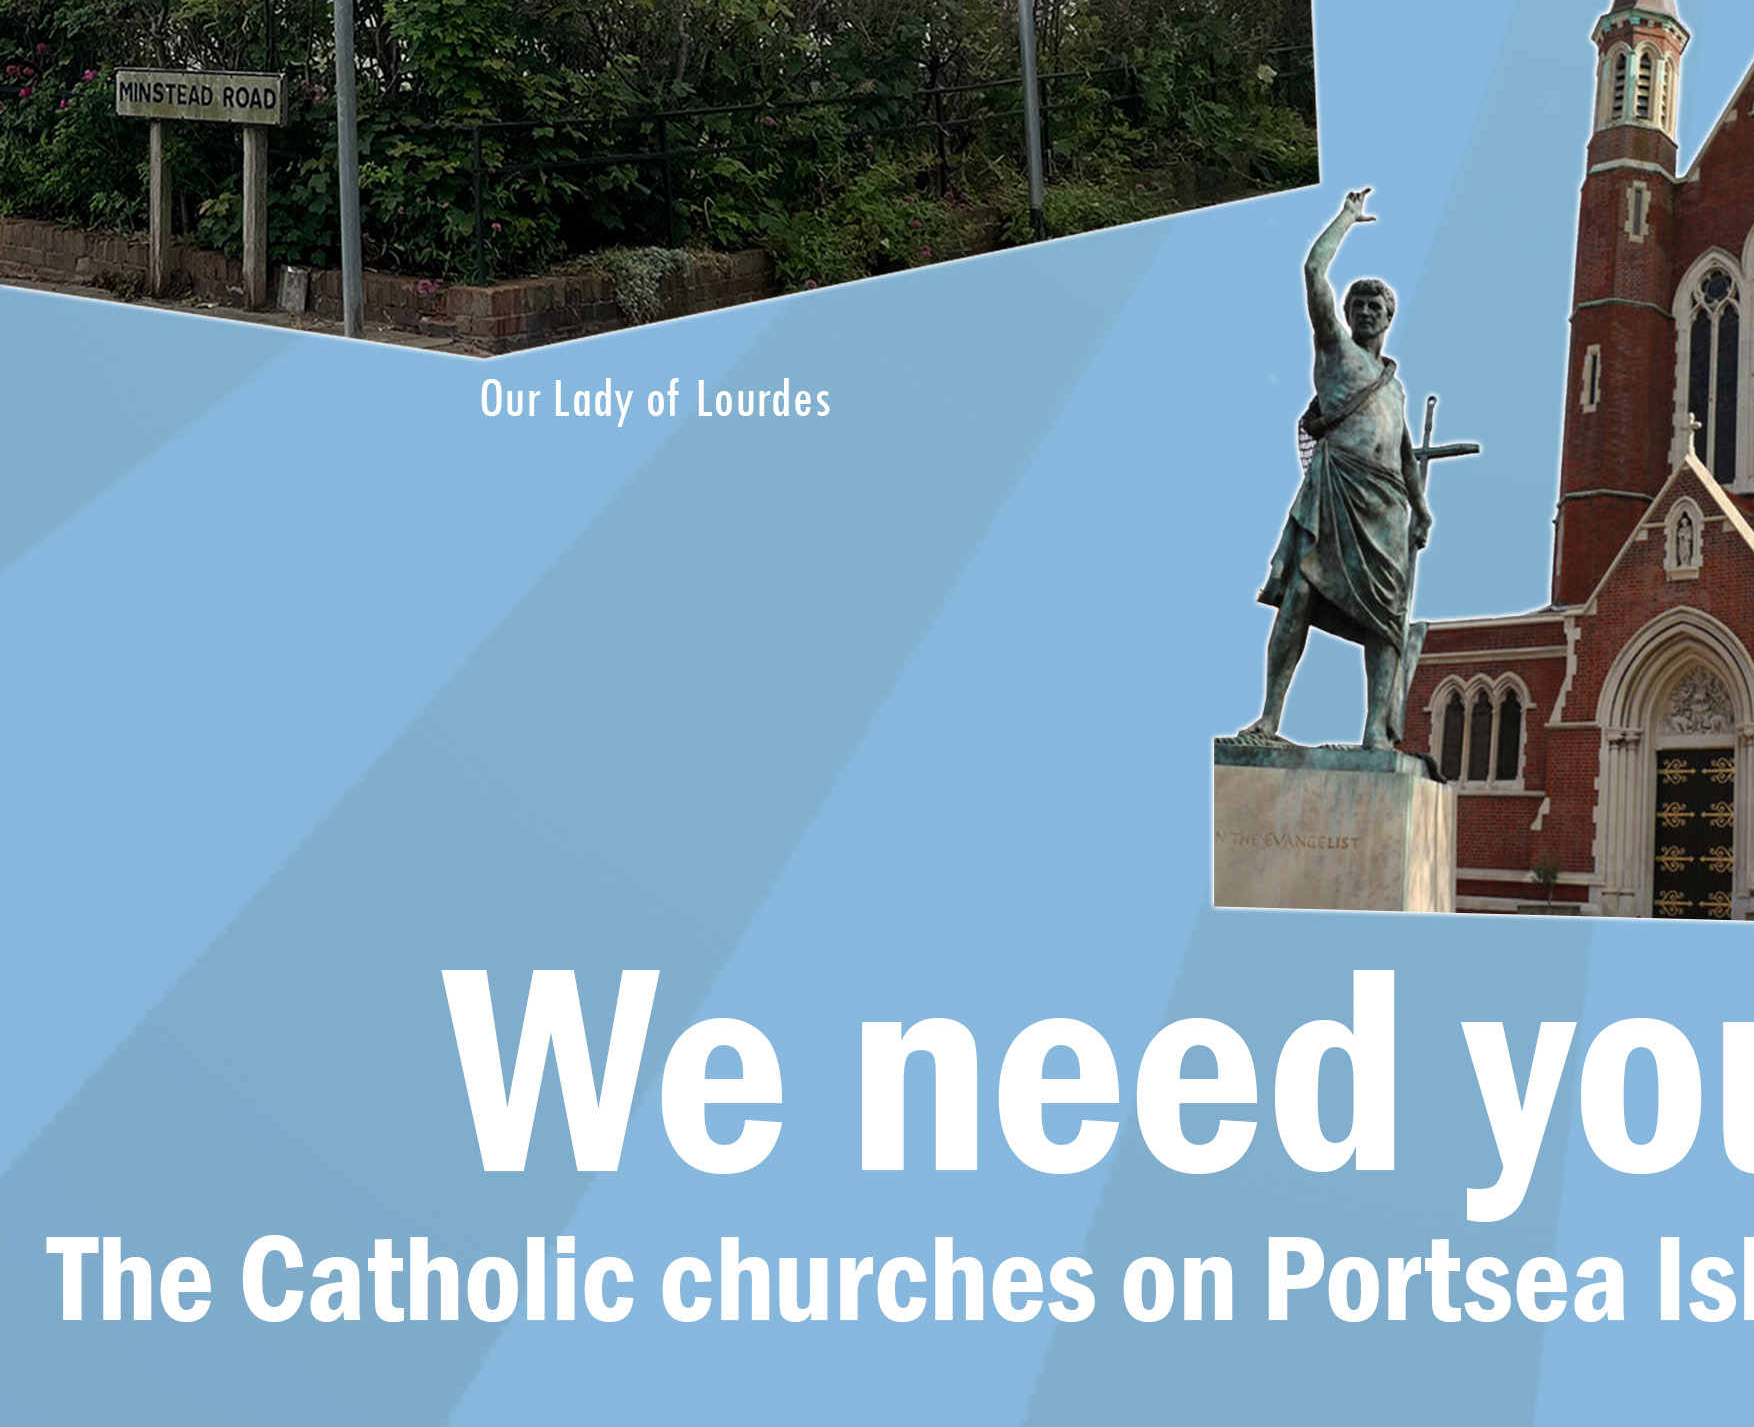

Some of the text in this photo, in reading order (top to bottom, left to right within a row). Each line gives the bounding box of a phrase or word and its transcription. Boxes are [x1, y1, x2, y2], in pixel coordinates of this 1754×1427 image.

[119, 81, 277, 110] MINSTEAD ROAD
[1231, 831, 1260, 846] THE
[1264, 832, 1359, 849] EVANGELIST
[440, 968, 784, 1176] We
[860, 968, 1396, 1176] need
[45, 1235, 212, 1324] The
[241, 1233, 635, 1324] Catholic
[661, 1235, 1096, 1324] churches
[1122, 1255, 1234, 1324] on
[1267, 1235, 1626, 1324] Portsea
